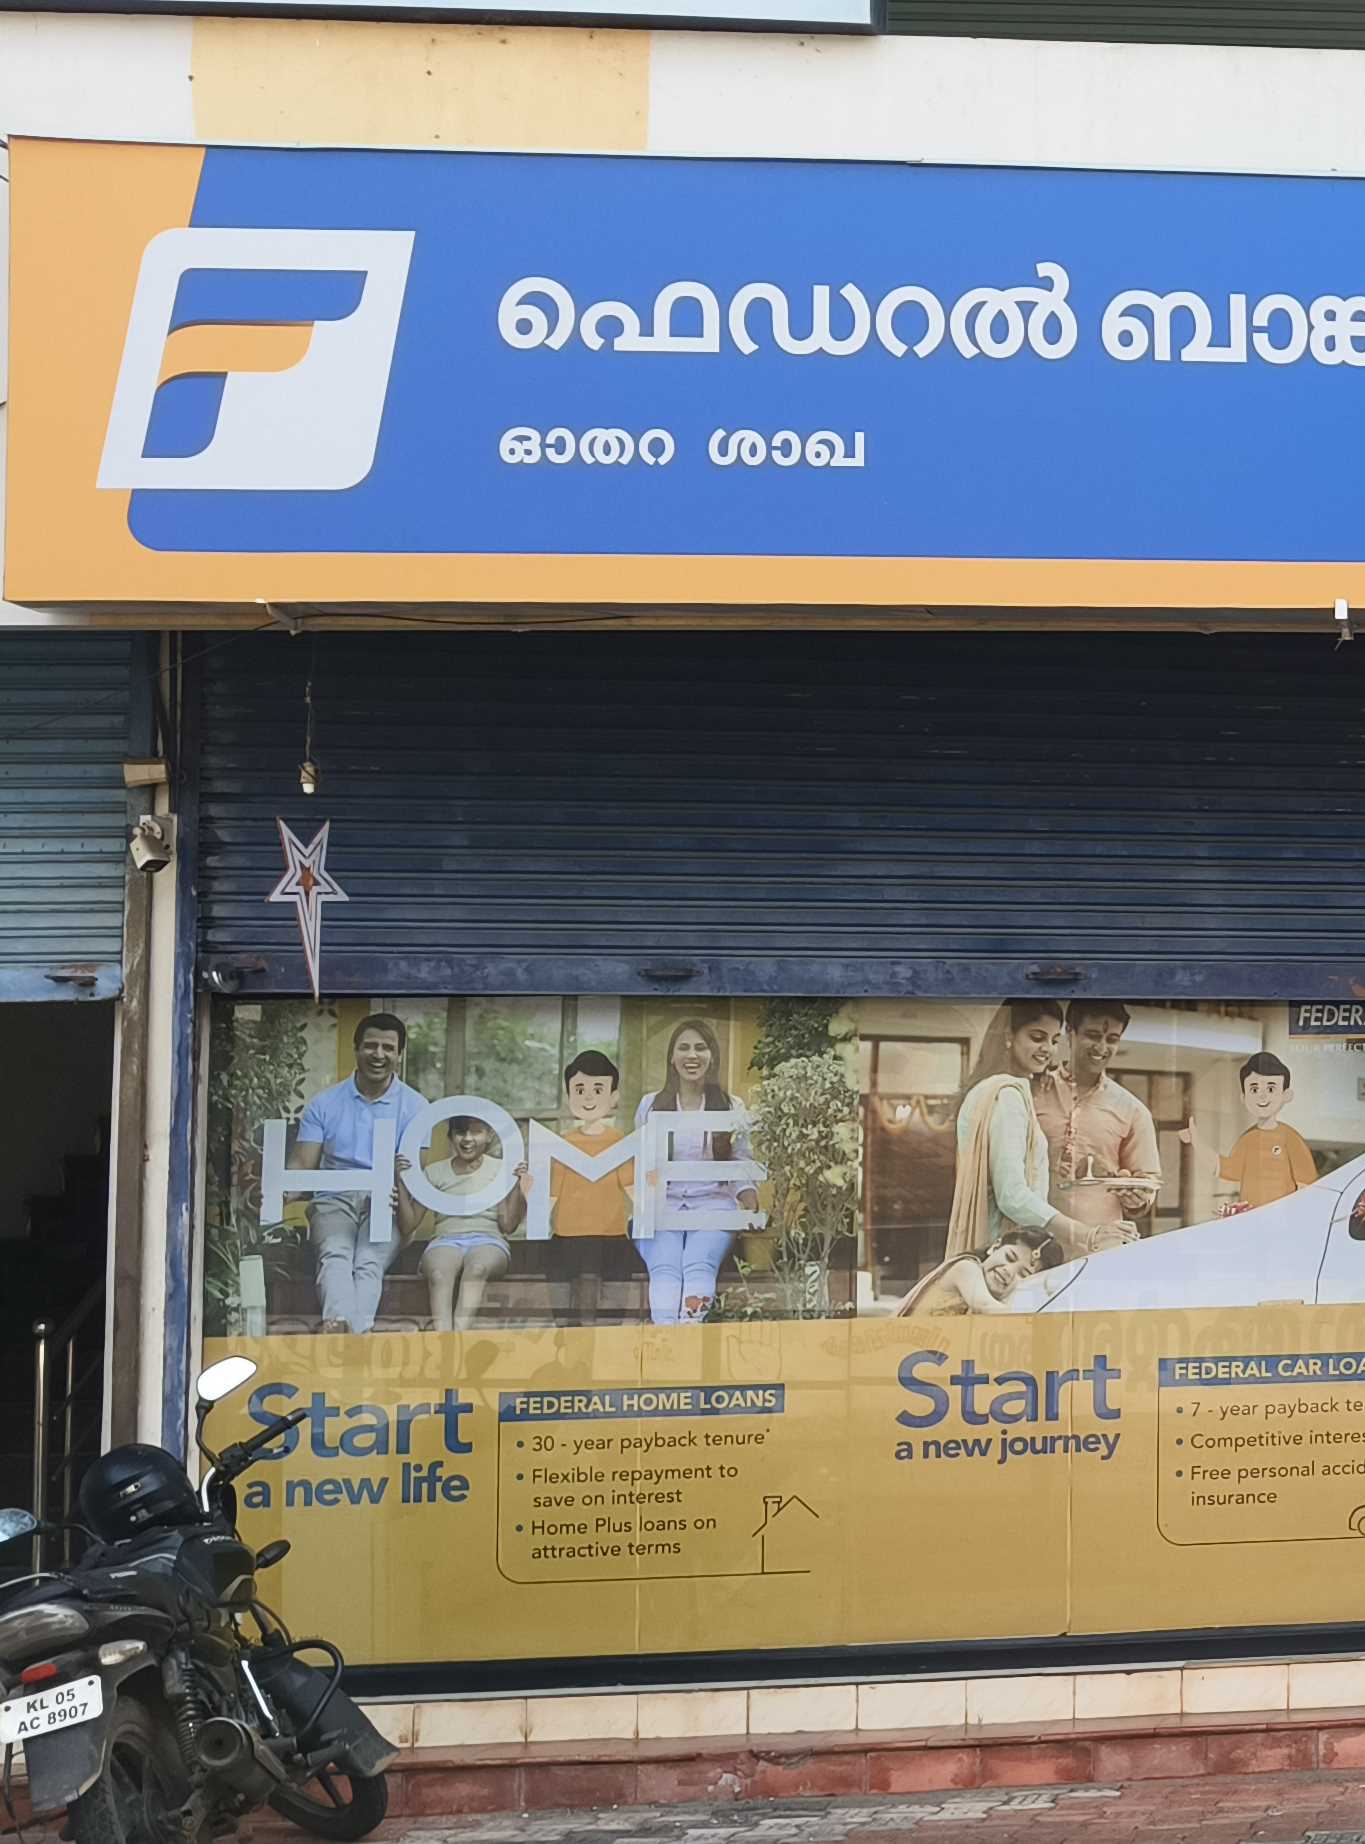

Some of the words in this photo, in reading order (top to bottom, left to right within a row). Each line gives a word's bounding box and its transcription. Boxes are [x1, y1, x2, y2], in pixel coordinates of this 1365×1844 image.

[498, 262, 1078, 361] ഫെഡറൽ
[498, 426, 676, 467] ഓതറ
[707, 427, 865, 468] ശാഖ
[259, 1094, 769, 1243] HOME
[1174, 1361, 1274, 1381] FEDERAL
[1277, 1359, 1324, 1378] CAR
[514, 1393, 616, 1416] FEDERAL
[622, 1391, 693, 1413] HOME
[698, 1389, 777, 1411] LOANS
[894, 1348, 1122, 1430] Start
[245, 1381, 474, 1461] Start
[894, 1438, 914, 1461] a
[921, 1433, 993, 1459] new
[996, 1425, 1122, 1465] journey
[1190, 1430, 1304, 1452] Competitive
[243, 1480, 272, 1510] a
[283, 1473, 390, 1508] new
[401, 1460, 470, 1505] life
[531, 1465, 606, 1486] Flexible
[611, 1465, 711, 1487] repayment
[716, 1464, 739, 1480] to
[1190, 1463, 1233, 1482] Free
[1237, 1460, 1317, 1483] personal
[1190, 1489, 1278, 1507] insurance
[531, 1539, 622, 1560] attractive
[627, 1539, 681, 1557] terms
[26, 1697, 49, 1714] KL
[55, 1688, 76, 1705] 05
[17, 1716, 41, 1735] AC
[47, 1702, 89, 1726] 8907
